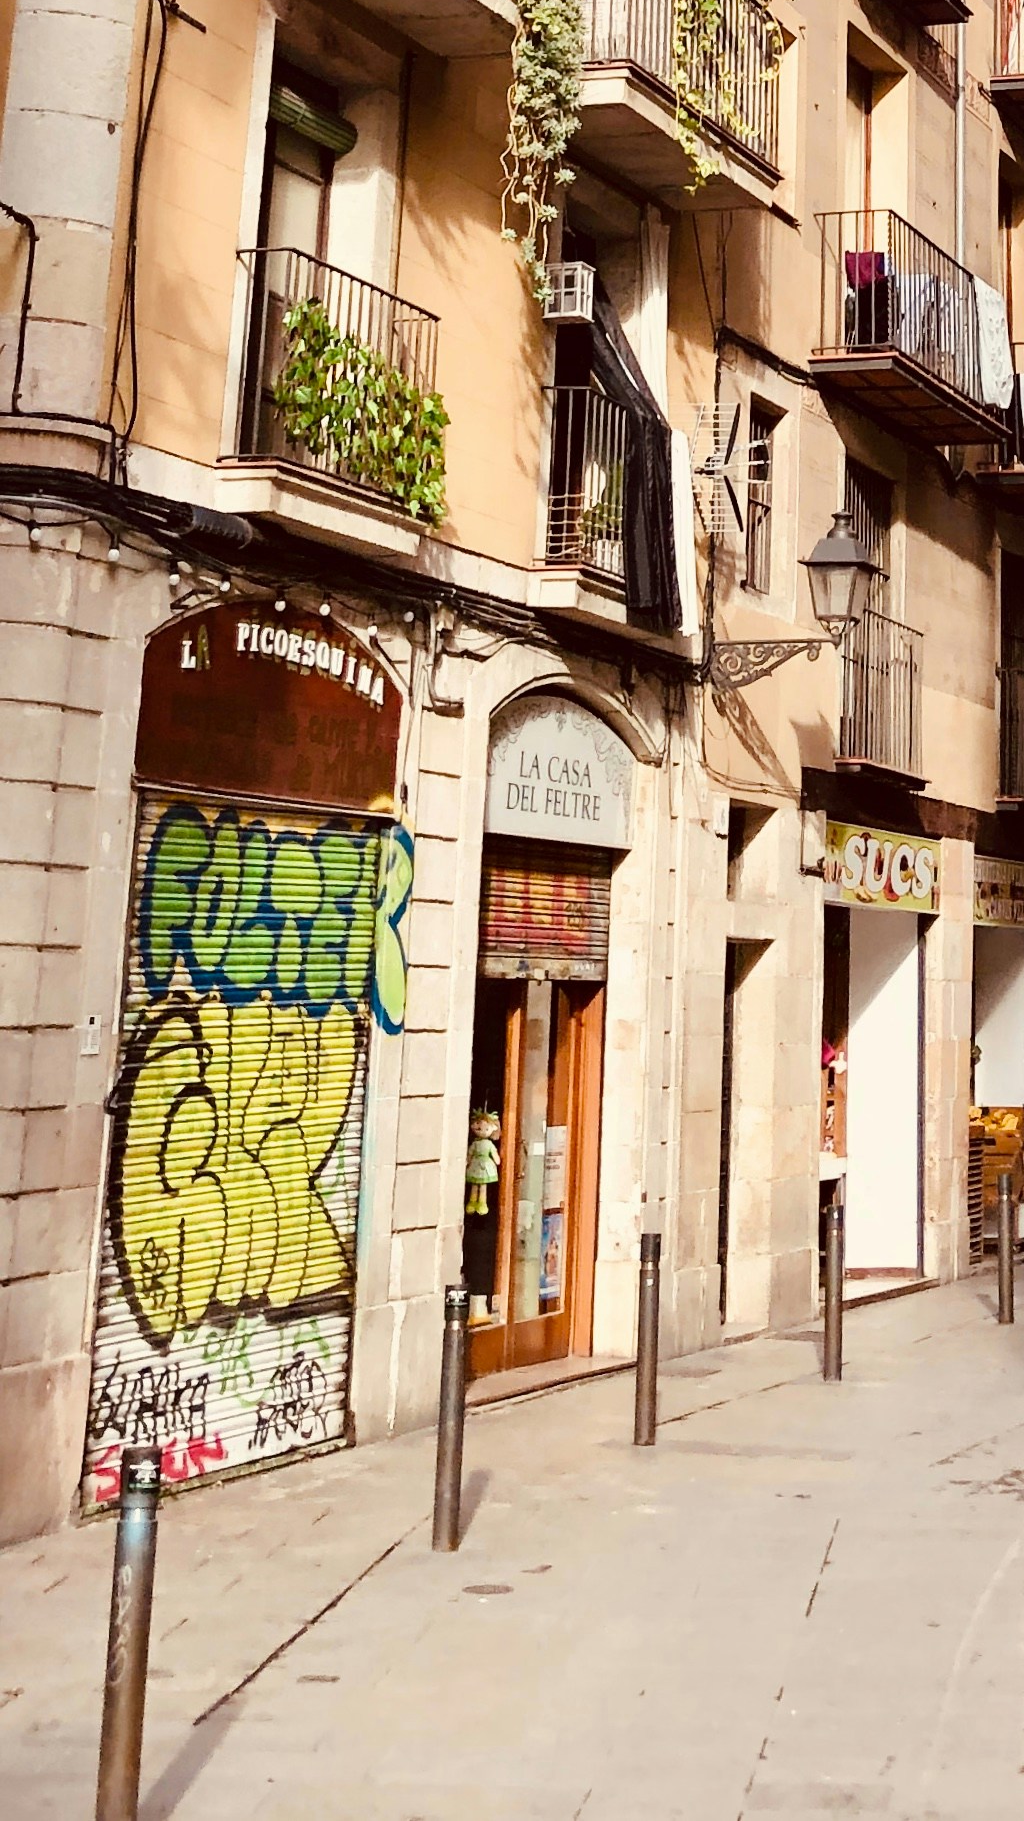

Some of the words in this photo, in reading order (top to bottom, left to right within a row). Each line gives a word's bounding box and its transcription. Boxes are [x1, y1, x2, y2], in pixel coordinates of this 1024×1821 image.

[519, 751, 541, 780] LA
[547, 756, 592, 788] CASA
[506, 782, 538, 814] DEL
[544, 787, 601, 821] FELTRE
[841, 833, 935, 900] SUCS
